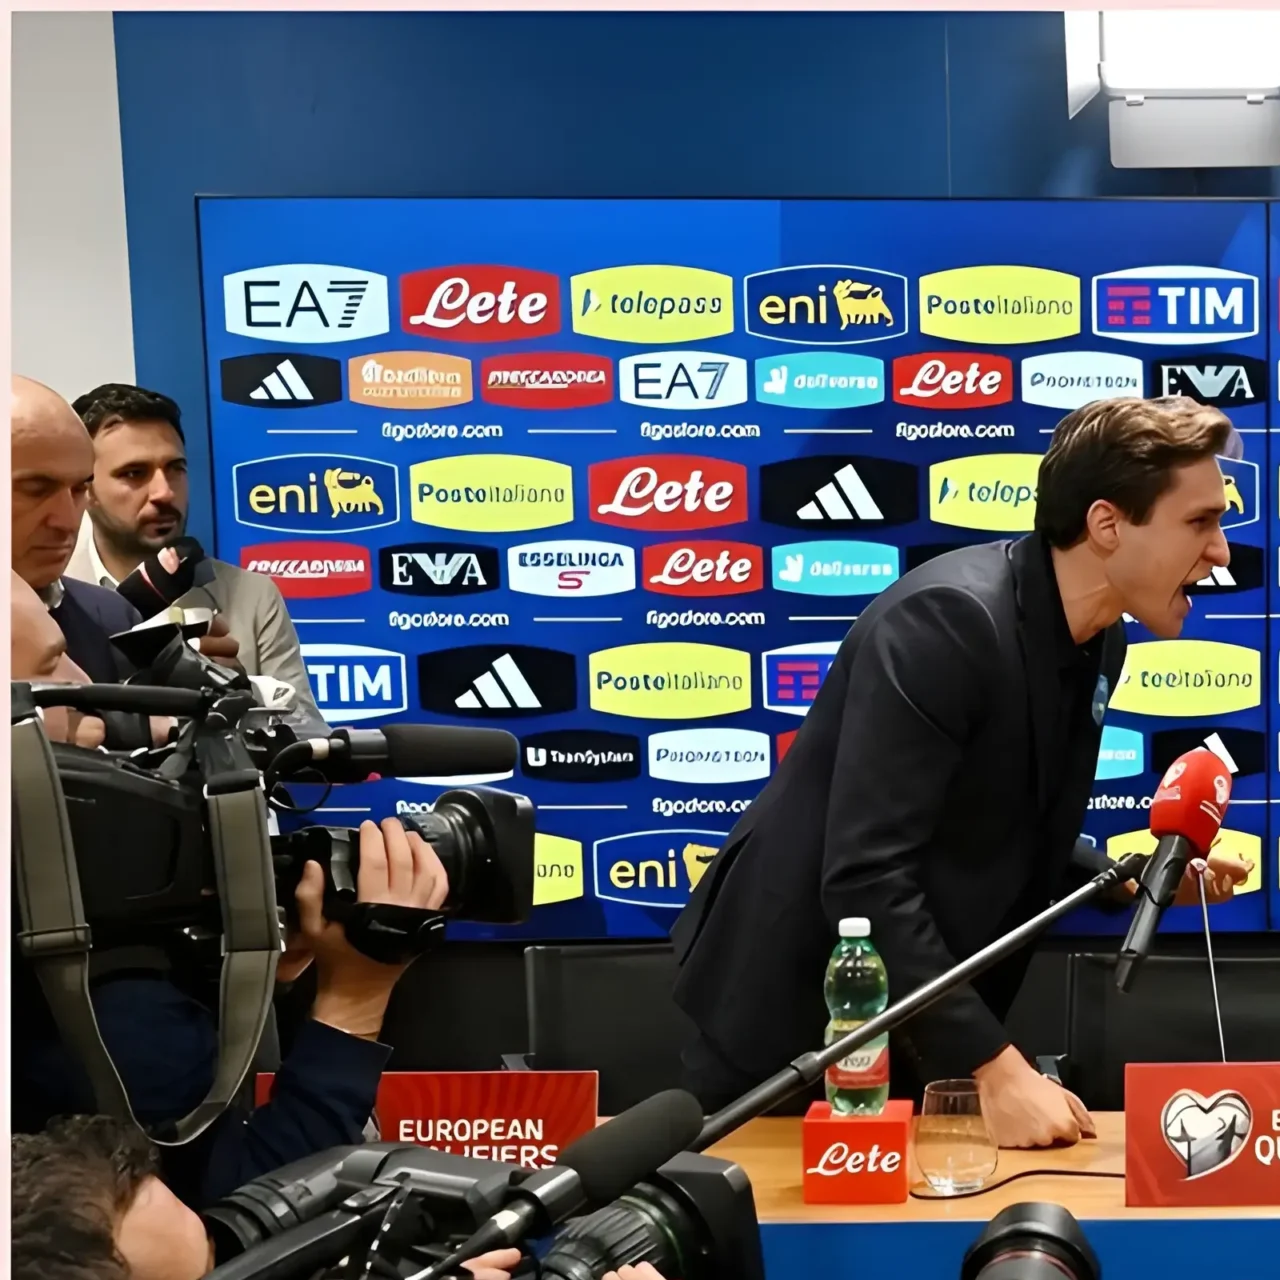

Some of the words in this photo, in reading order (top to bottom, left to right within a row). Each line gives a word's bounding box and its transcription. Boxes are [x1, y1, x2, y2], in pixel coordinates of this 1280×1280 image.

[243, 280, 368, 329] EA7
[410, 277, 547, 329] Lete
[758, 285, 826, 325] eni
[1159, 287, 1243, 325] TIM
[634, 362, 729, 399] EA7
[900, 360, 1001, 396] Lete
[249, 472, 318, 514] eni
[597, 467, 734, 516] Lete
[650, 548, 751, 584] Lete
[308, 664, 391, 701] TIM
[609, 848, 676, 888] eni
[399, 1119, 544, 1142] EUROPEAN
[807, 1142, 902, 1176] Lete
